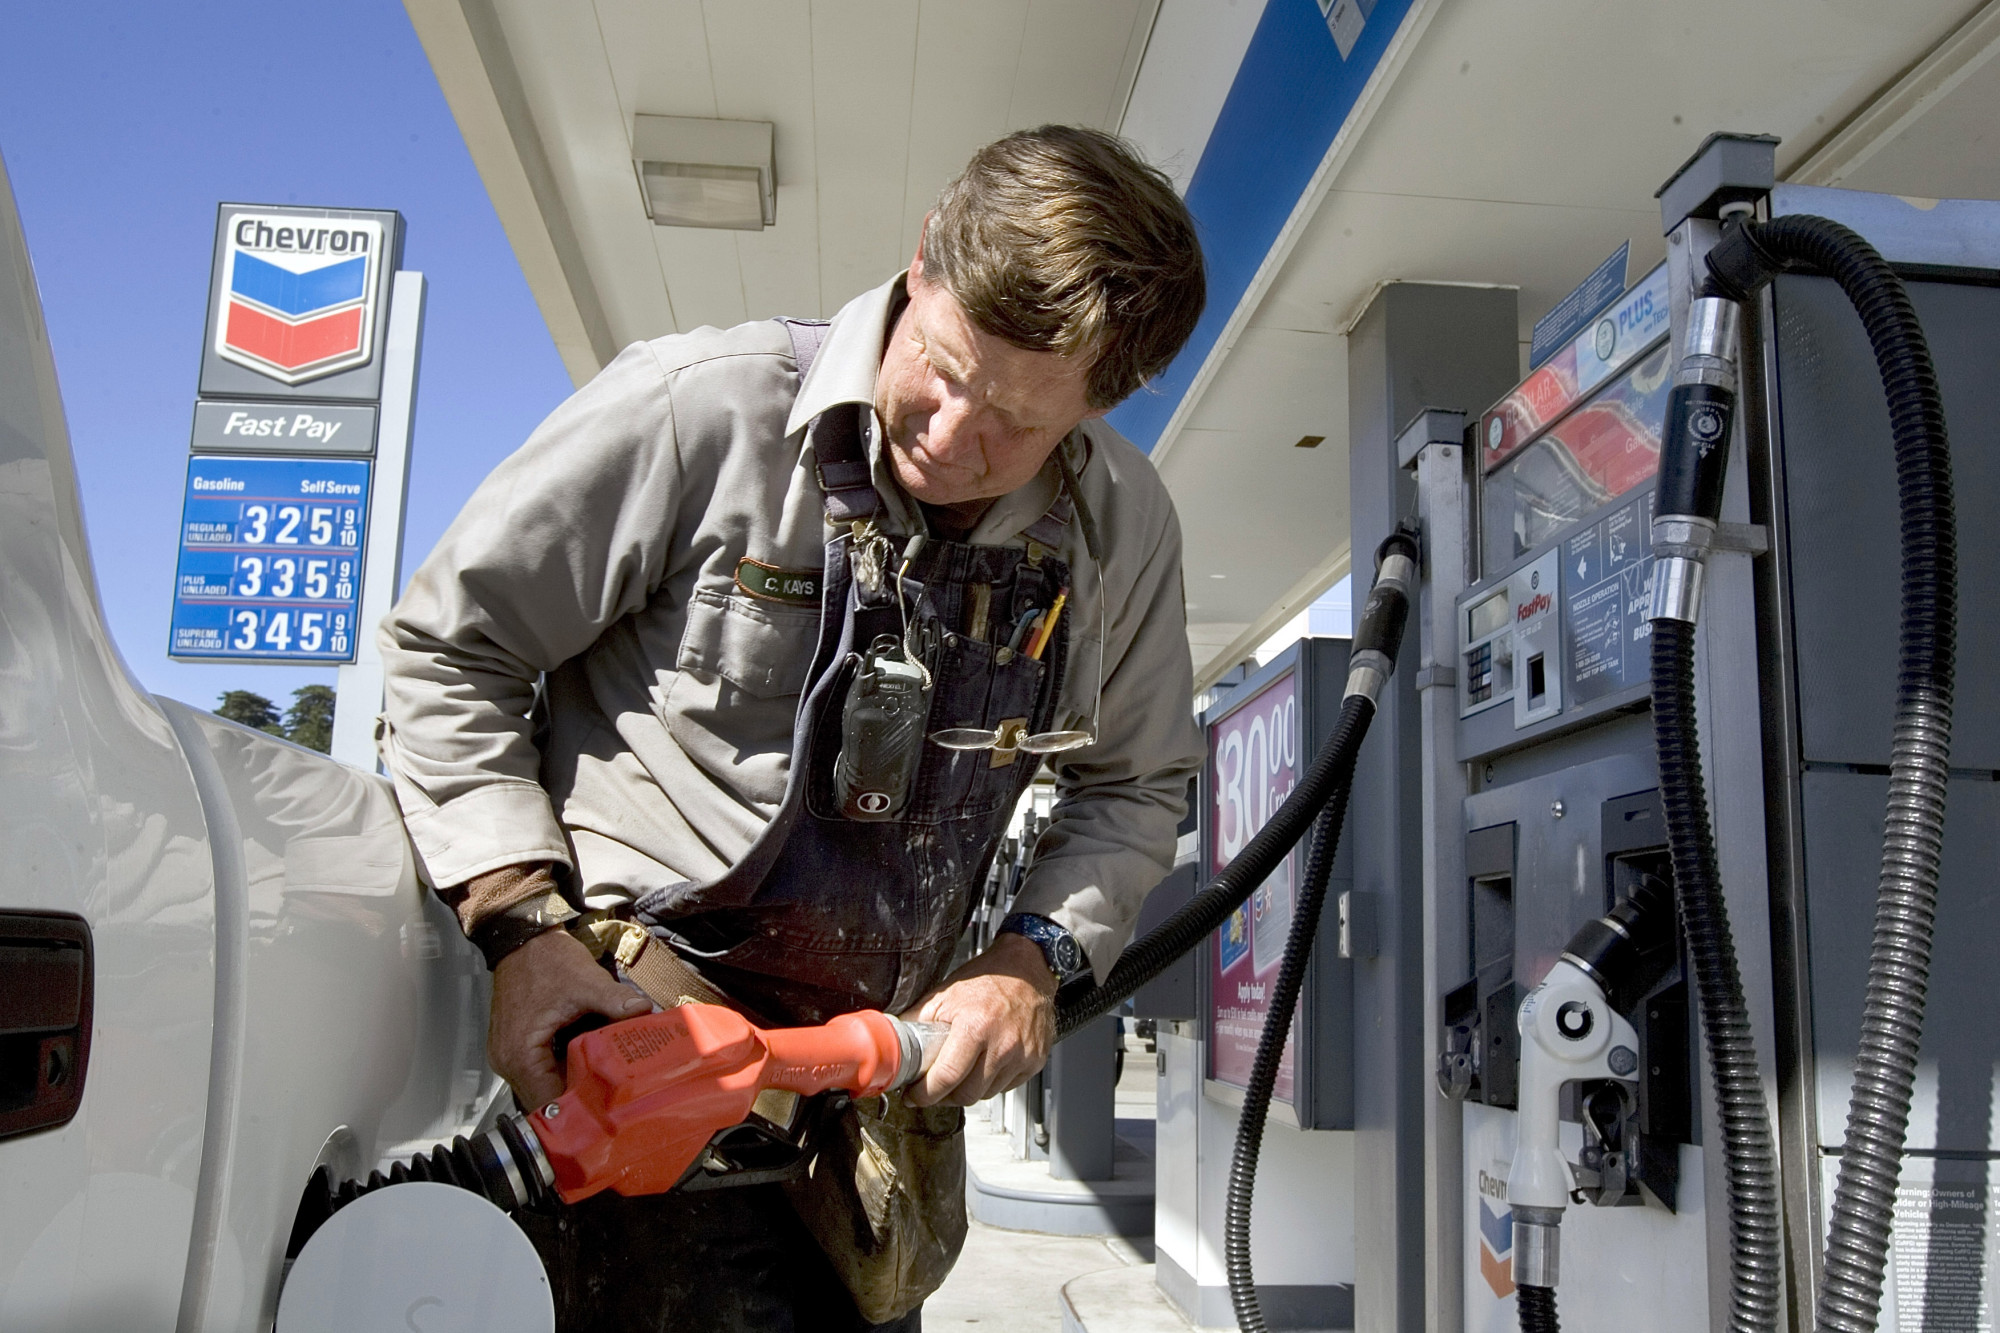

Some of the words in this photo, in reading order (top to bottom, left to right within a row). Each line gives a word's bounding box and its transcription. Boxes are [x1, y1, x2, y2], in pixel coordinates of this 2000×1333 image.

[236, 220, 370, 253] Chevron
[1619, 289, 1653, 337] PLUS
[1624, 396, 1644, 414] Sale
[224, 412, 286, 438] Fast
[289, 414, 342, 443] Pay
[1625, 422, 1661, 454] Gallons
[193, 476, 245, 492] Gasoline
[300, 480, 326, 494] Self
[326, 481, 361, 495] Serve
[188, 523, 228, 533] REGULAR
[243, 505, 332, 546] 325
[188, 532, 232, 543] UNLEADED
[184, 576, 206, 586] PLUS
[238, 557, 328, 599] 335
[764, 576, 779, 592] C.
[782, 578, 814, 596] KAYS
[183, 585, 227, 596] UNLEADED
[1572, 596, 1591, 613] NOZZLE
[1591, 582, 1620, 603] OPERATION
[1516, 591, 1554, 624] FastPay
[178, 628, 218, 639] SUPREME
[234, 610, 323, 652] 345
[177, 638, 222, 648] UNLEADED
[1238, 982, 1250, 1004] Apply
[1251, 982, 1266, 1004] today!
[1478, 1170, 1507, 1200] Chevr
[1931, 1188, 1964, 1198] Owners
[1966, 1190, 1975, 1198] of
[1894, 1208, 1929, 1219] Vehicles
[1929, 1199, 1984, 1211] High-Mileage
